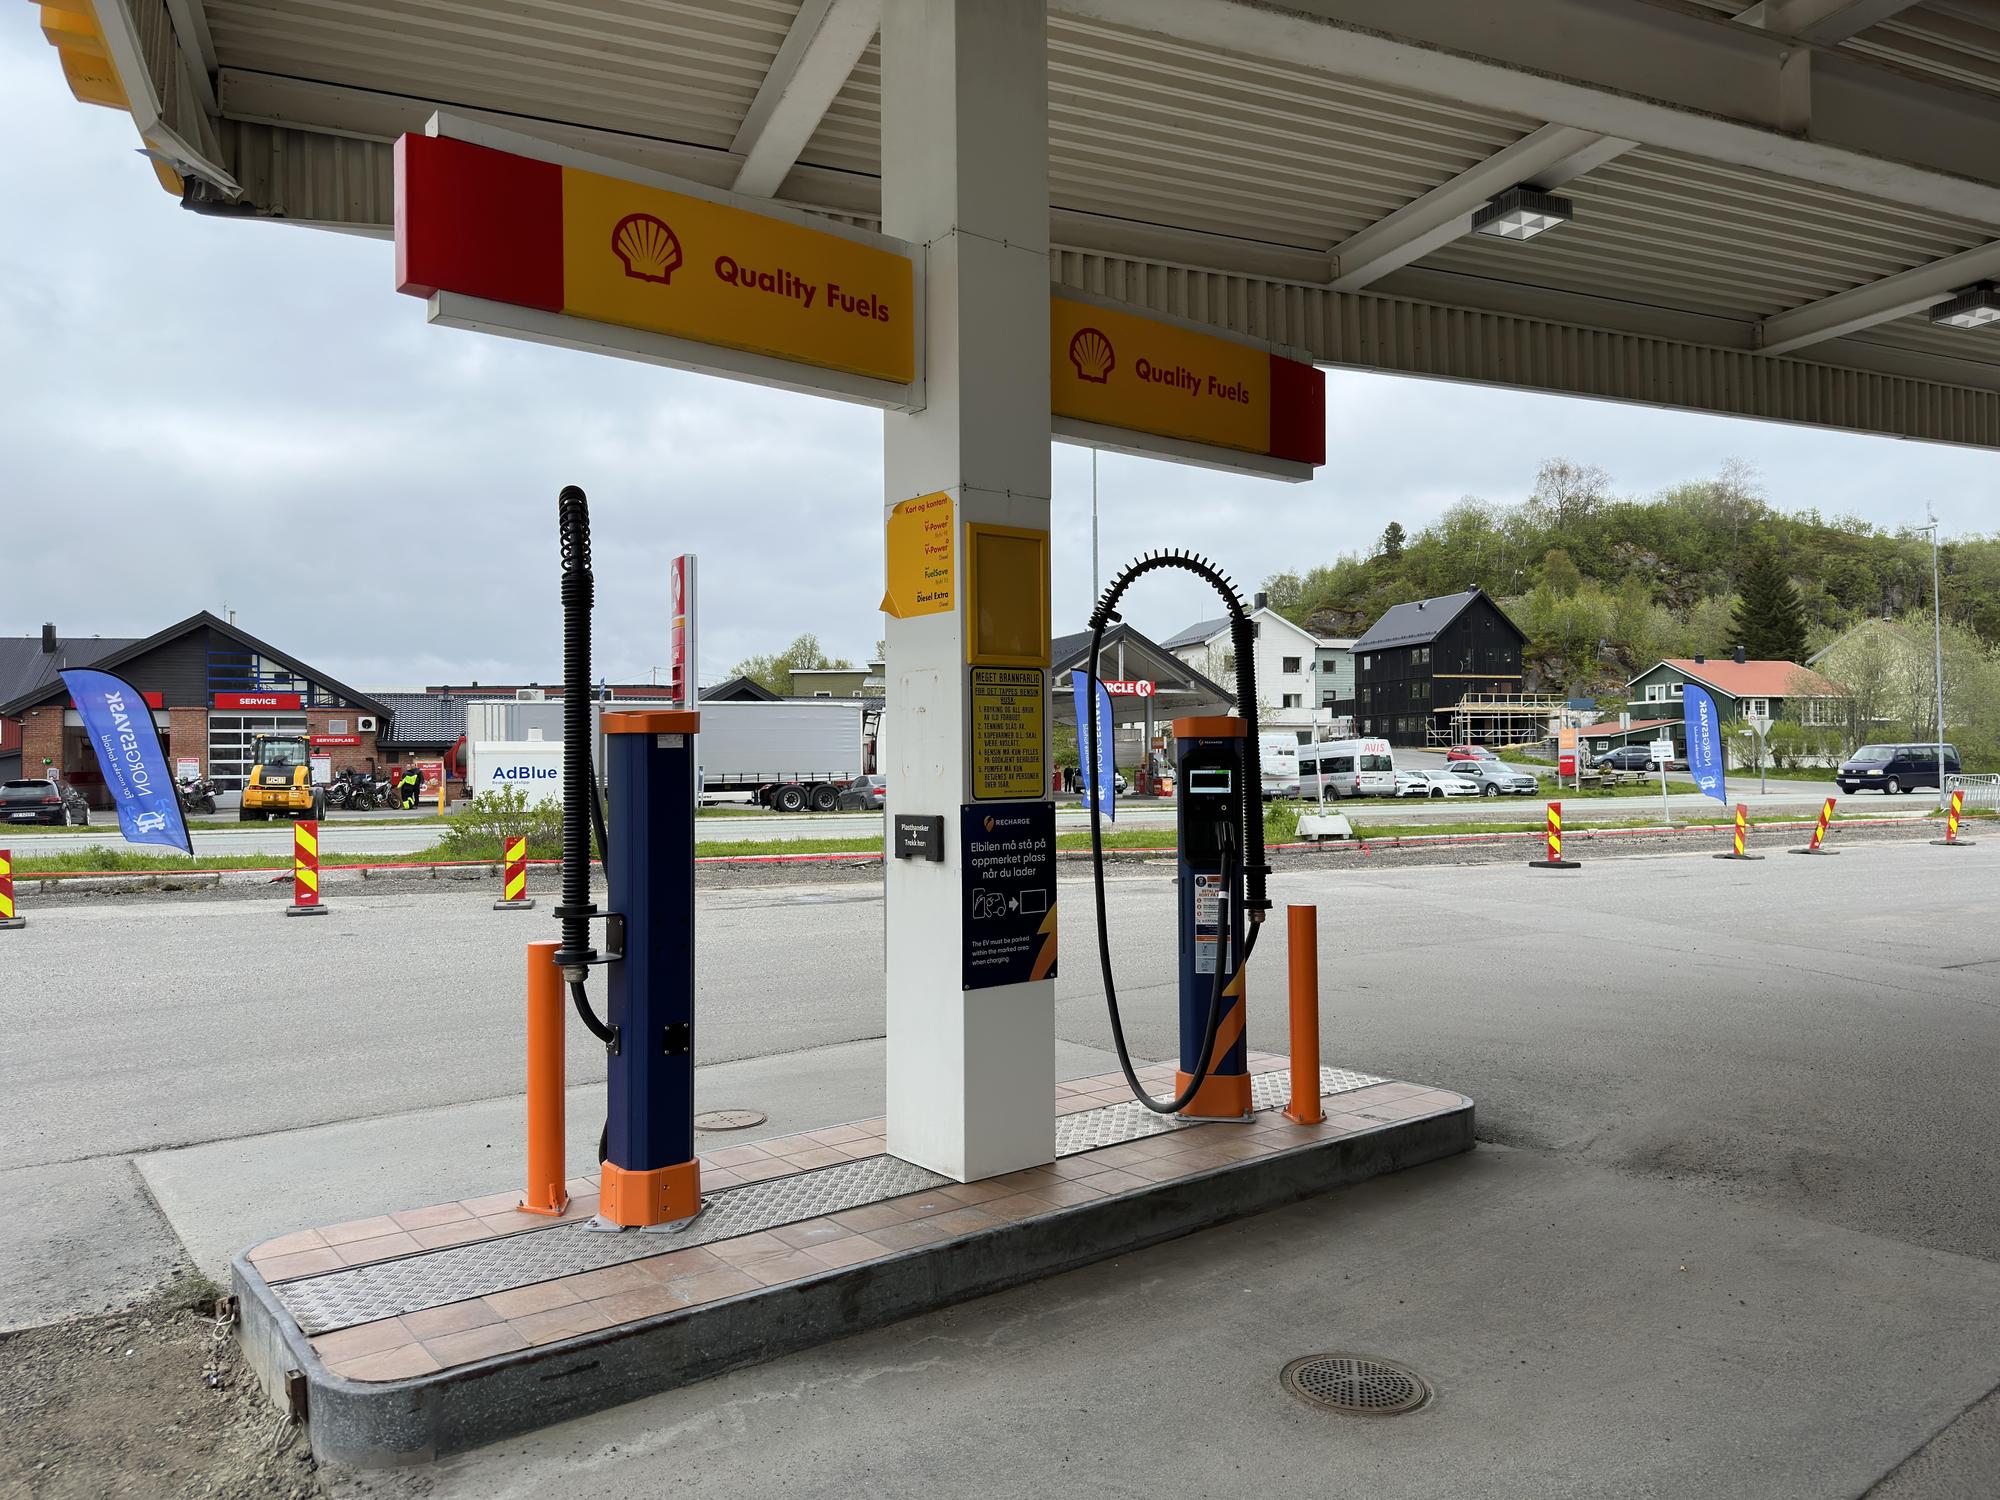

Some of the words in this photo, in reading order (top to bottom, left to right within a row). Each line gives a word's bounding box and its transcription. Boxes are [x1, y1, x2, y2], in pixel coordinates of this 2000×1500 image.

[714, 256, 817, 309] Quality
[826, 283, 890, 323] Fuels
[1136, 358, 1202, 397] Quality
[1207, 375, 1250, 405] Fuels
[924, 521, 949, 533] V-Power
[924, 544, 949, 556] V-Power
[924, 568, 949, 580] FuelSave
[917, 592, 933, 603] Diesel
[975, 672, 996, 683] MEGET
[999, 672, 1040, 684] BRANNFARLIG
[1364, 743, 1386, 752] AVIS
[492, 766, 558, 780] AdBlue
[995, 818, 1031, 826] RECHARGE
[970, 841, 1001, 853] Elbilen
[1002, 841, 1017, 851] må
[1018, 840, 1033, 850] stå
[1034, 839, 1046, 852] på
[971, 855, 1022, 868] oppmerket
[1023, 853, 1046, 865] plass
[982, 868, 998, 879] når
[1000, 867, 1012, 878] du
[1013, 866, 1037, 877] lader
[990, 938, 1003, 946] must
[1003, 936, 1011, 944] be
[1011, 935, 1030, 945] parked
[972, 949, 987, 957] within
[988, 948, 997, 956] the
[997, 946, 1016, 954] marked
[972, 958, 984, 966] when
[986, 956, 1010, 967] charging
